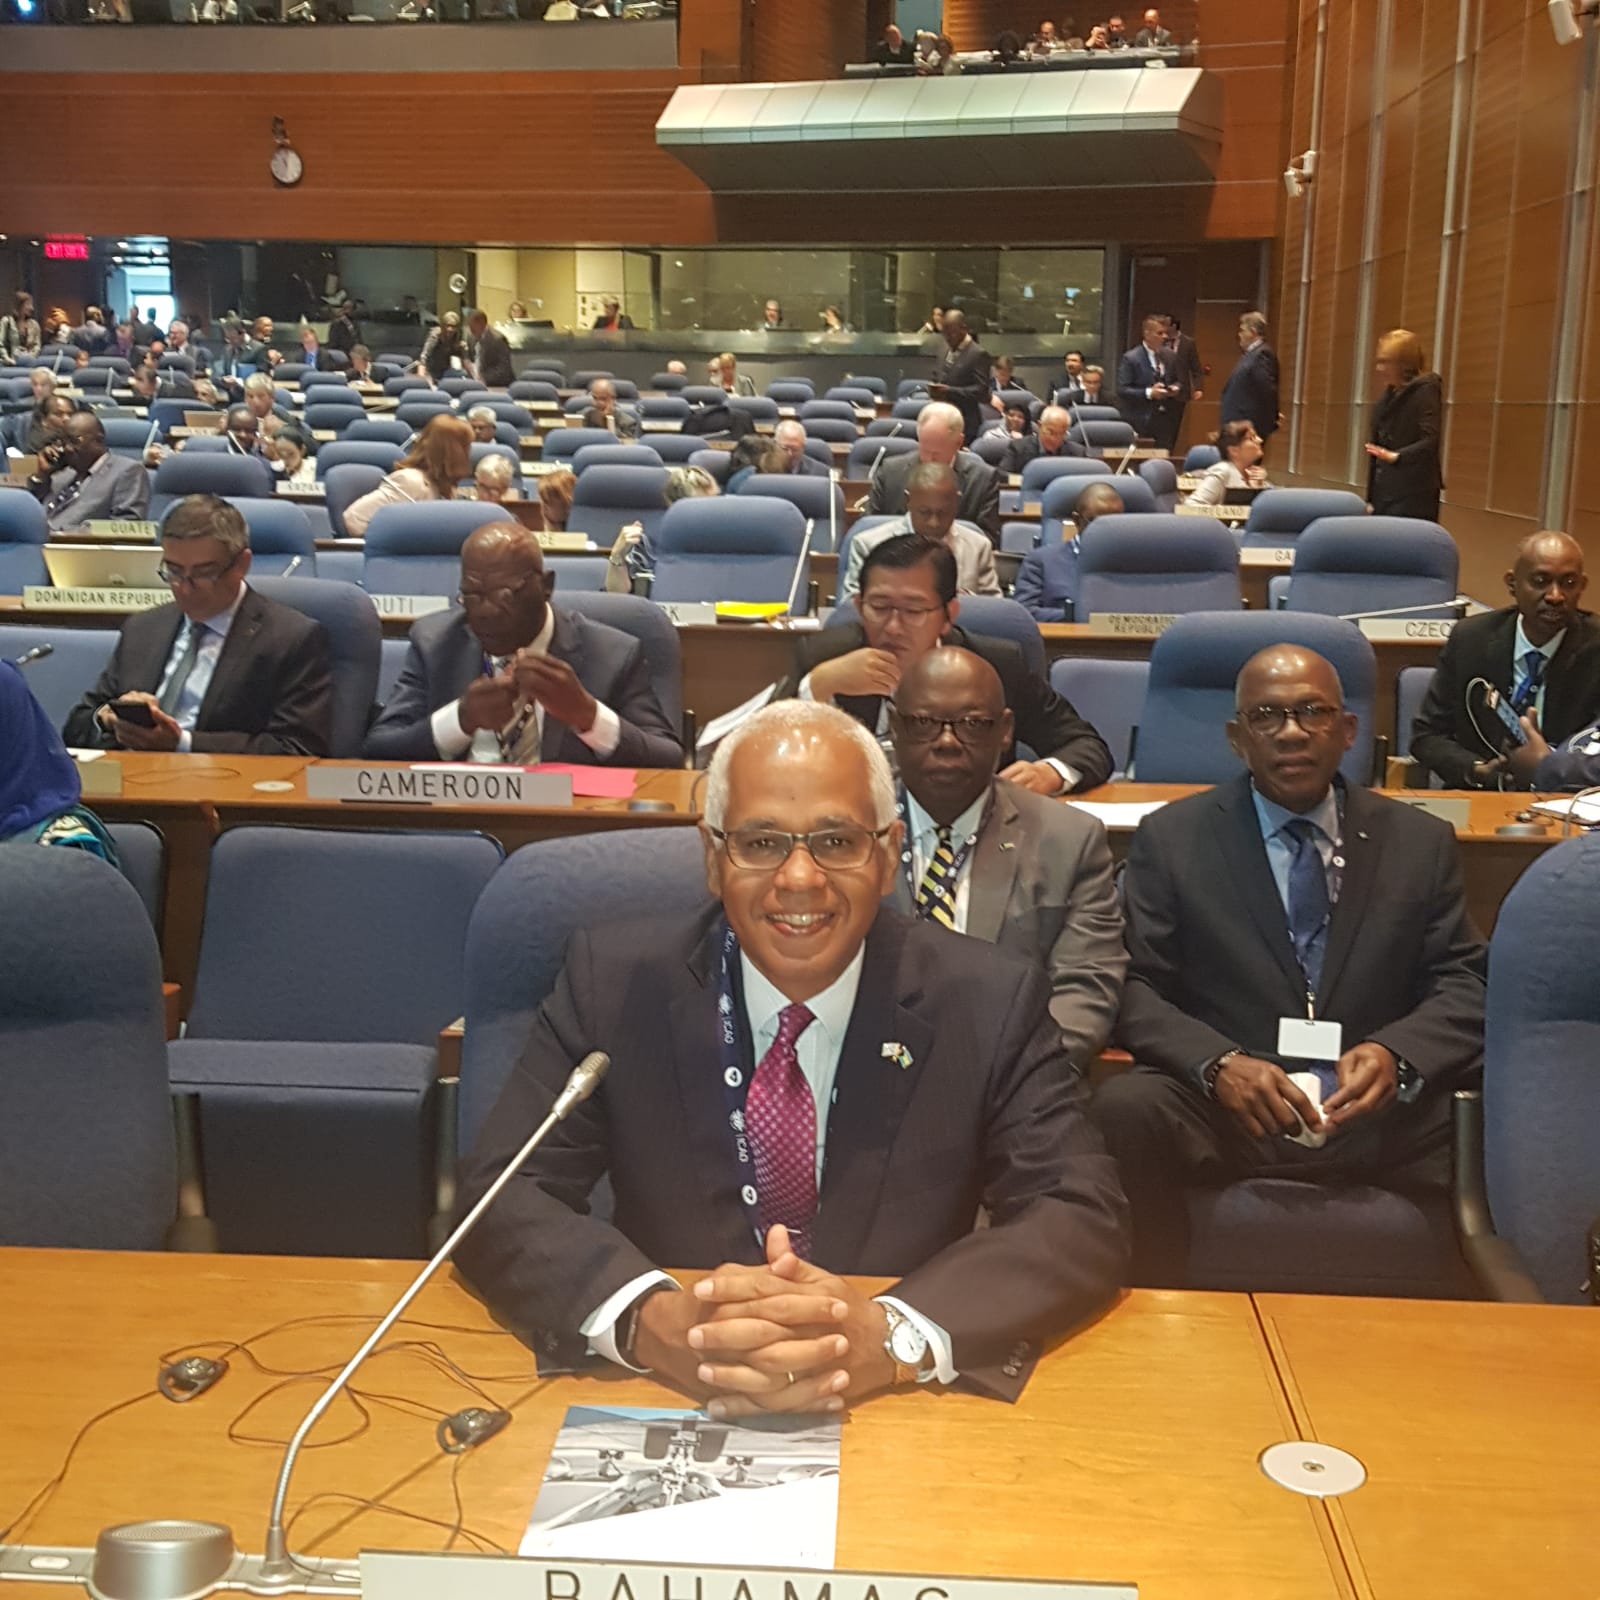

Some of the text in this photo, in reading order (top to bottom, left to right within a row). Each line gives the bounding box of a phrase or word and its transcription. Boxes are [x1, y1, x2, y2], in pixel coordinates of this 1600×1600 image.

[34, 590, 105, 603] DOMINICAN
[357, 771, 523, 800] CAMEROON
[545, 1569, 949, 1600] BAHA
